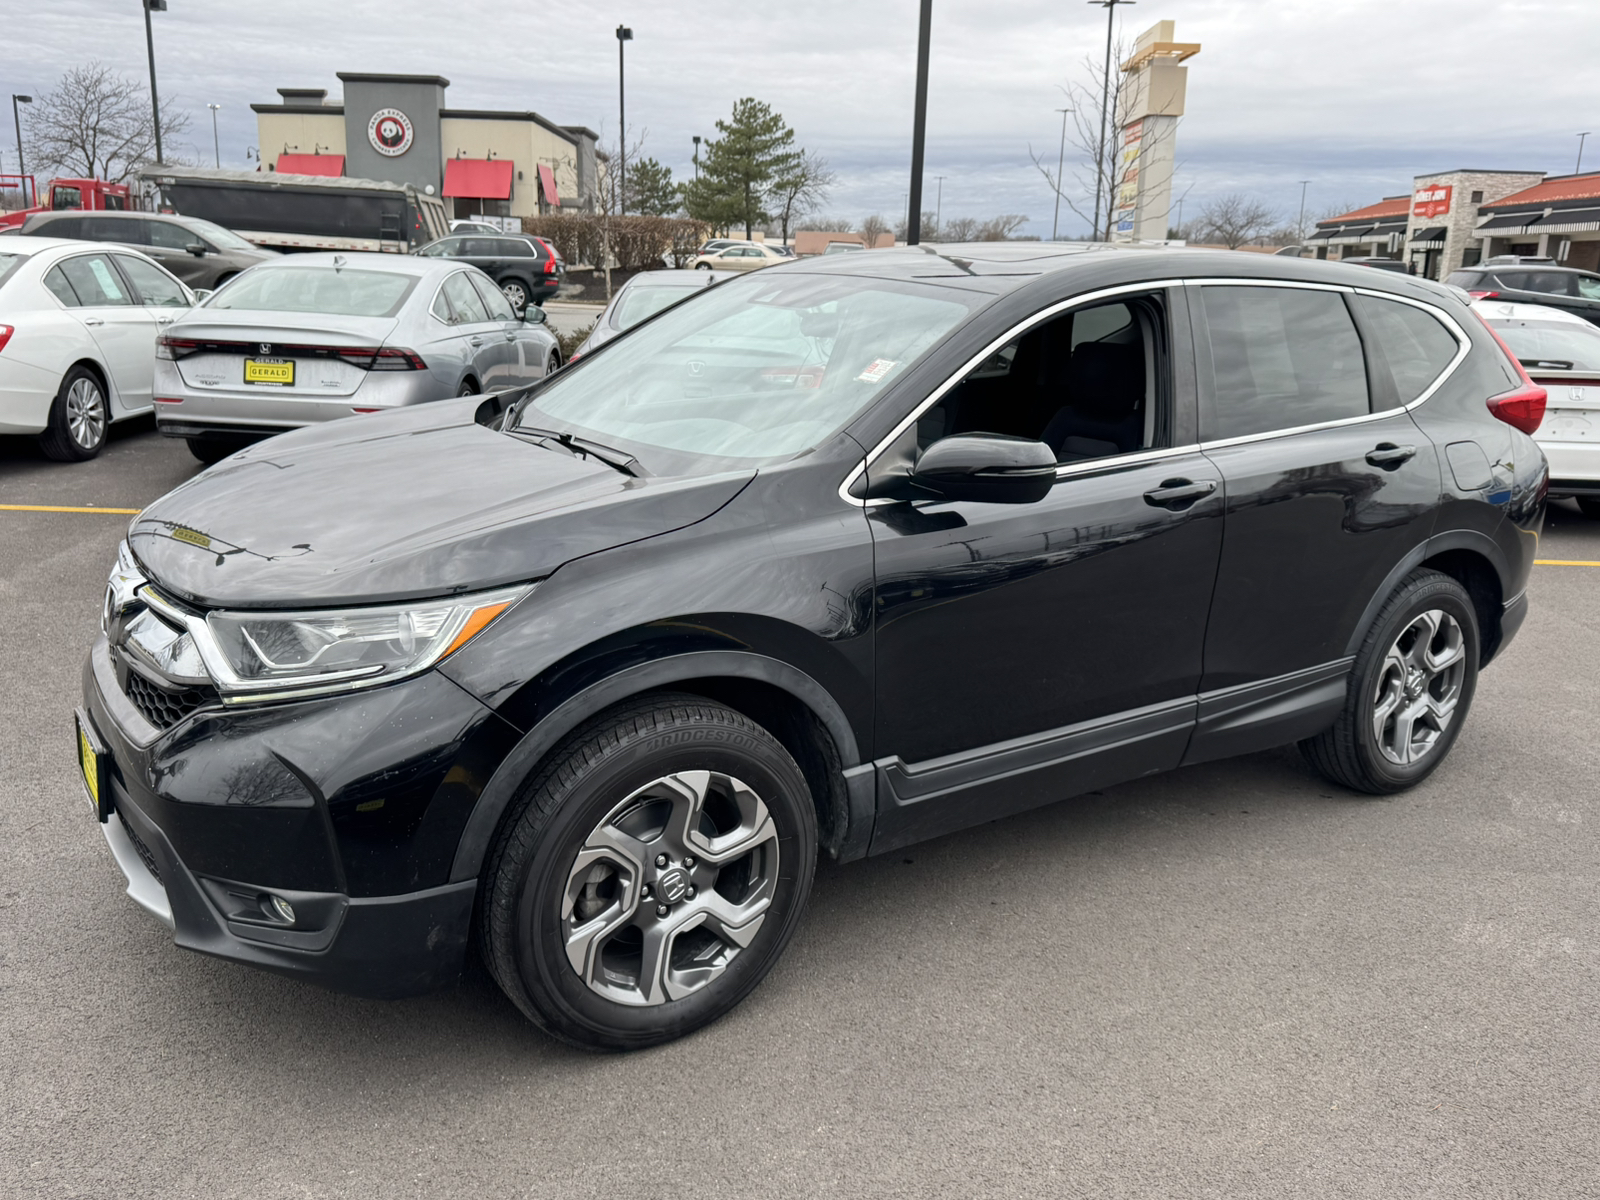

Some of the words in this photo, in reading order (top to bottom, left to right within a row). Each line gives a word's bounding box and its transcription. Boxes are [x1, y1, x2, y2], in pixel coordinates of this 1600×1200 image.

[387, 110, 411, 131] EXPRESS
[251, 368, 287, 376] GERALD
[646, 730, 764, 753] BRIDGESTONE
